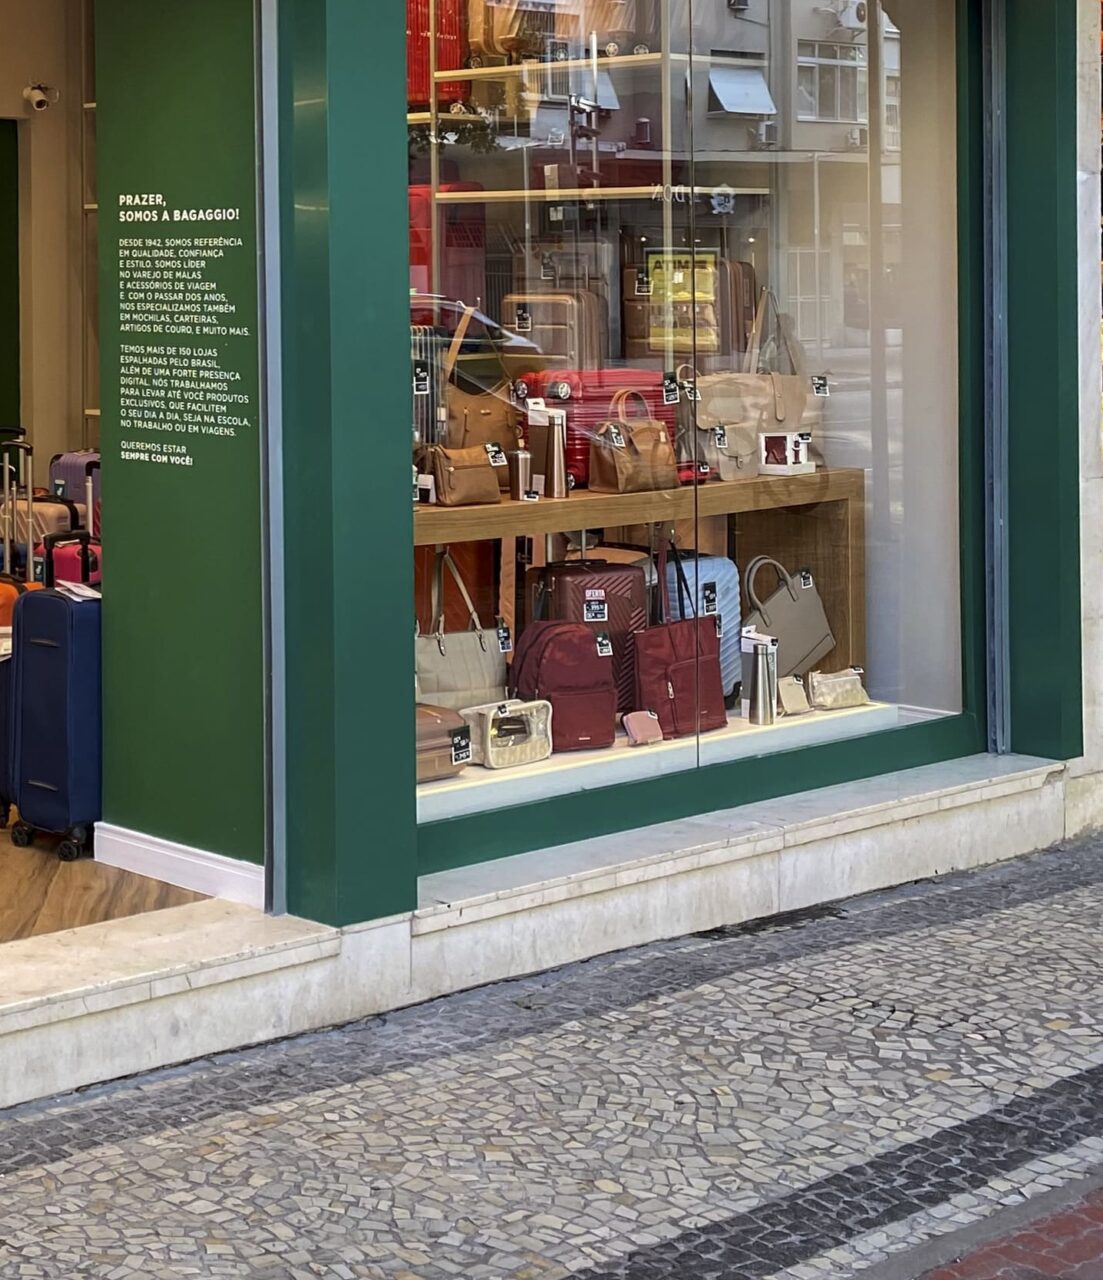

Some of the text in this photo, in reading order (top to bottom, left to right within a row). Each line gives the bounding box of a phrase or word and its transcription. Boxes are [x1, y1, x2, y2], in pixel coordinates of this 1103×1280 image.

[119, 194, 167, 207] PRAZER,
[119, 208, 240, 222] SOMOS A BAGAGGIO!
[119, 239, 143, 247] DESDE
[165, 238, 192, 246] SOMOS
[194, 236, 243, 246] REFERÊNCIA
[119, 249, 130, 257] EM
[179, 249, 224, 258] CONFIANÇA
[119, 260, 125, 268] E
[155, 260, 182, 268] SOMOS
[183, 259, 206, 268] LÍDER
[120, 271, 202, 279] NO VAREJO DE MALAS
[120, 280, 216, 290] E ACESSÓRIOS DE VIAGEM
[128, 292, 144, 300] COM
[147, 292, 153, 300] O
[186, 293, 202, 301] DOS
[120, 302, 236, 313] NOS ESPECIALIZAMOS TAMBÉM
[120, 313, 219, 324] EM MOCHILAS, CARTEIRAS,
[120, 324, 151, 332] ARTIGOS
[203, 326, 227, 335] MUITO
[120, 344, 218, 357] TEMOS MAIS DE 150 LOJAS
[120, 355, 168, 365] ESPALHADAS
[170, 358, 189, 366] PELO
[120, 365, 241, 381] ALÉM DE UMA FORTE PRESENÇA
[170, 380, 228, 391] TRABALHAMOS
[120, 387, 249, 404] PARA LEVAR ATÉ VOCÊ PRODUTOS
[169, 401, 184, 410] QUE
[187, 403, 227, 413] FACILITEM
[120, 409, 126, 417] O
[128, 409, 142, 418] SEU
[144, 410, 157, 419] DIA
[183, 413, 202, 422] SEJA
[204, 415, 216, 423] NA
[217, 416, 251, 427] ESCOLA,
[121, 420, 131, 428] NO
[133, 420, 173, 431] TRABALHO
[175, 424, 186, 432] OU
[188, 425, 199, 433] EM
[121, 441, 187, 454] QUEREMOS ESTAR
[121, 451, 150, 461] SEMPRE
[151, 454, 168, 463] COM
